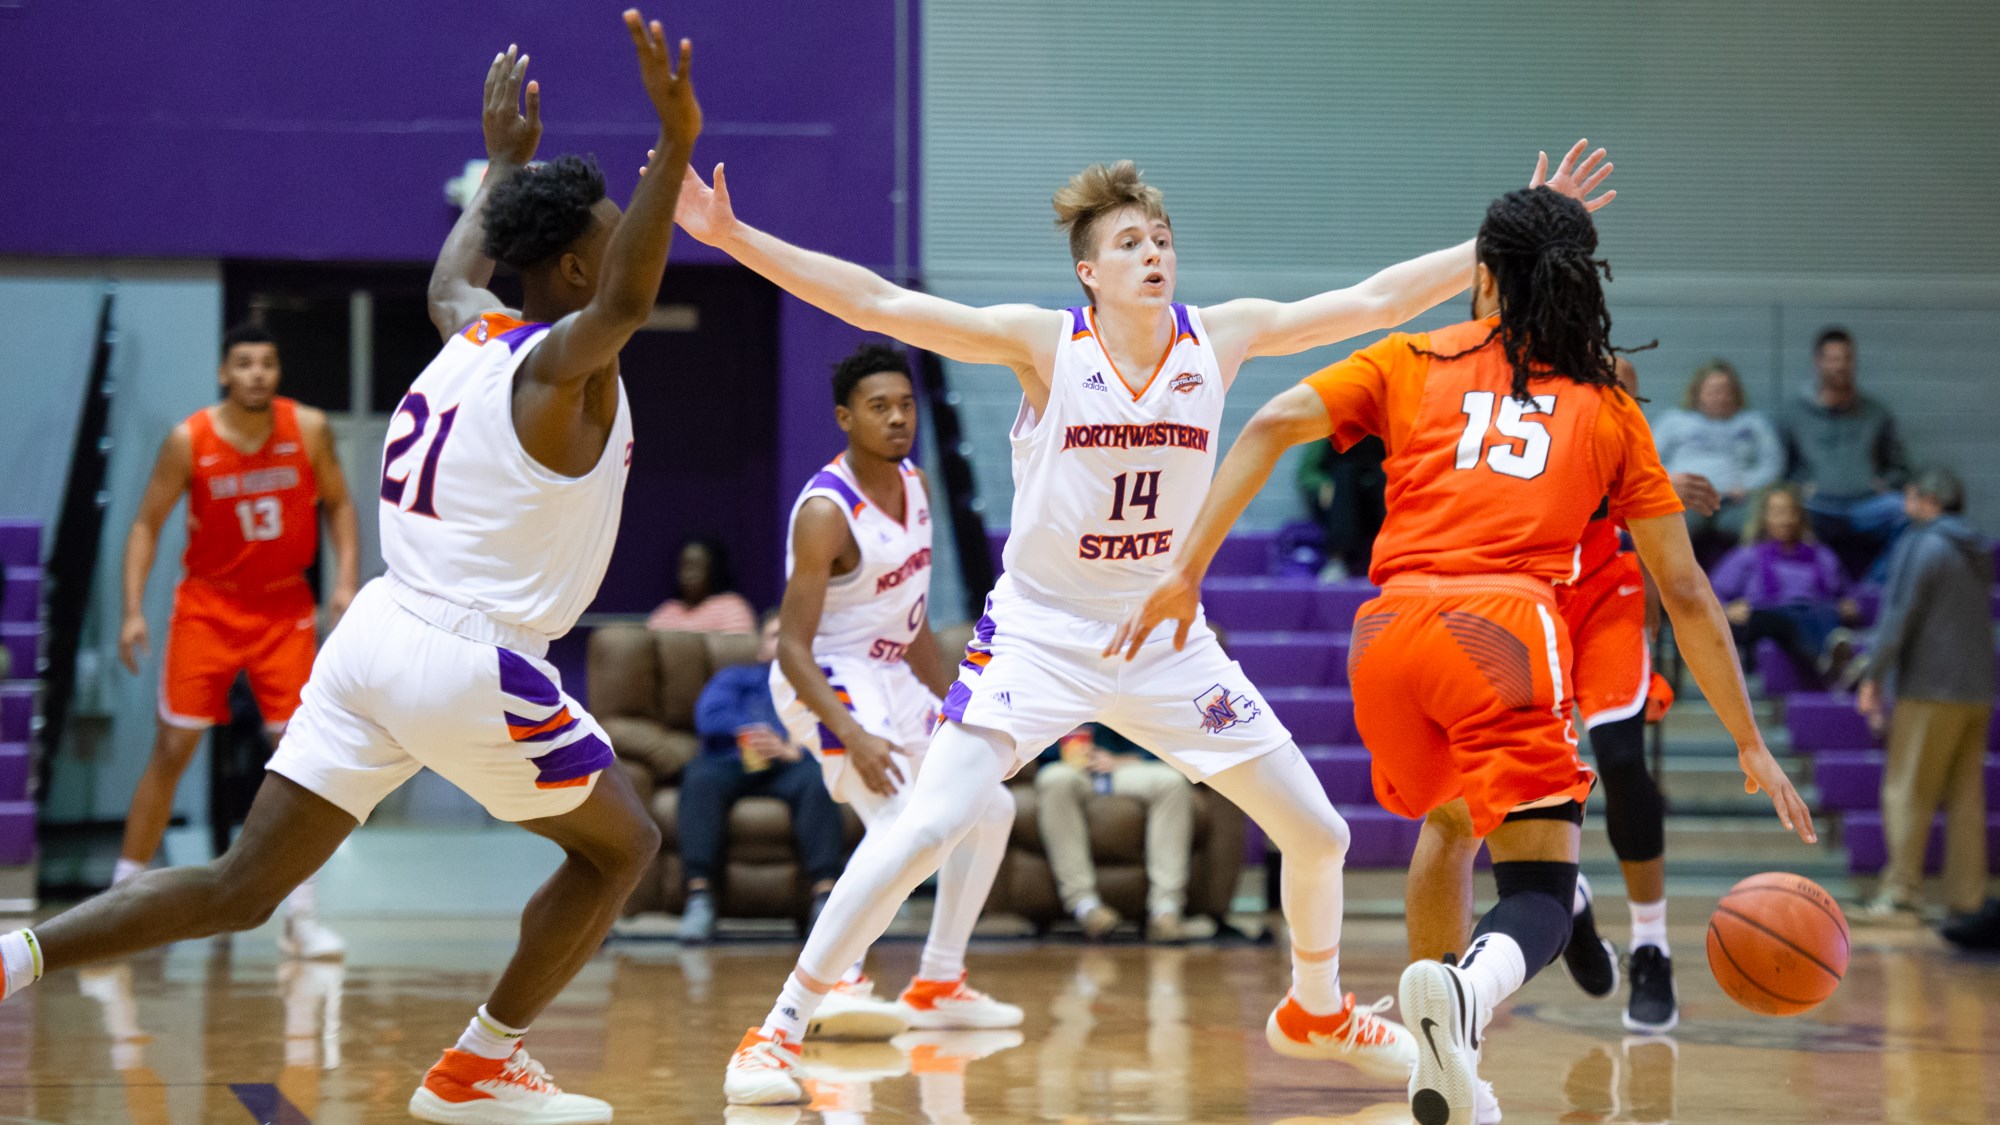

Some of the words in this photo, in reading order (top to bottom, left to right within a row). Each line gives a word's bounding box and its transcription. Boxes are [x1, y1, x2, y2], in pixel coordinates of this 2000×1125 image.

[380, 388, 459, 520] 21
[1061, 422, 1210, 453] NORTHWESTERN
[1454, 390, 1557, 480] 15
[1108, 470, 1162, 521] 14
[235, 496, 282, 542] 13
[1078, 529, 1173, 560] STATE
[908, 593, 925, 632] 0
